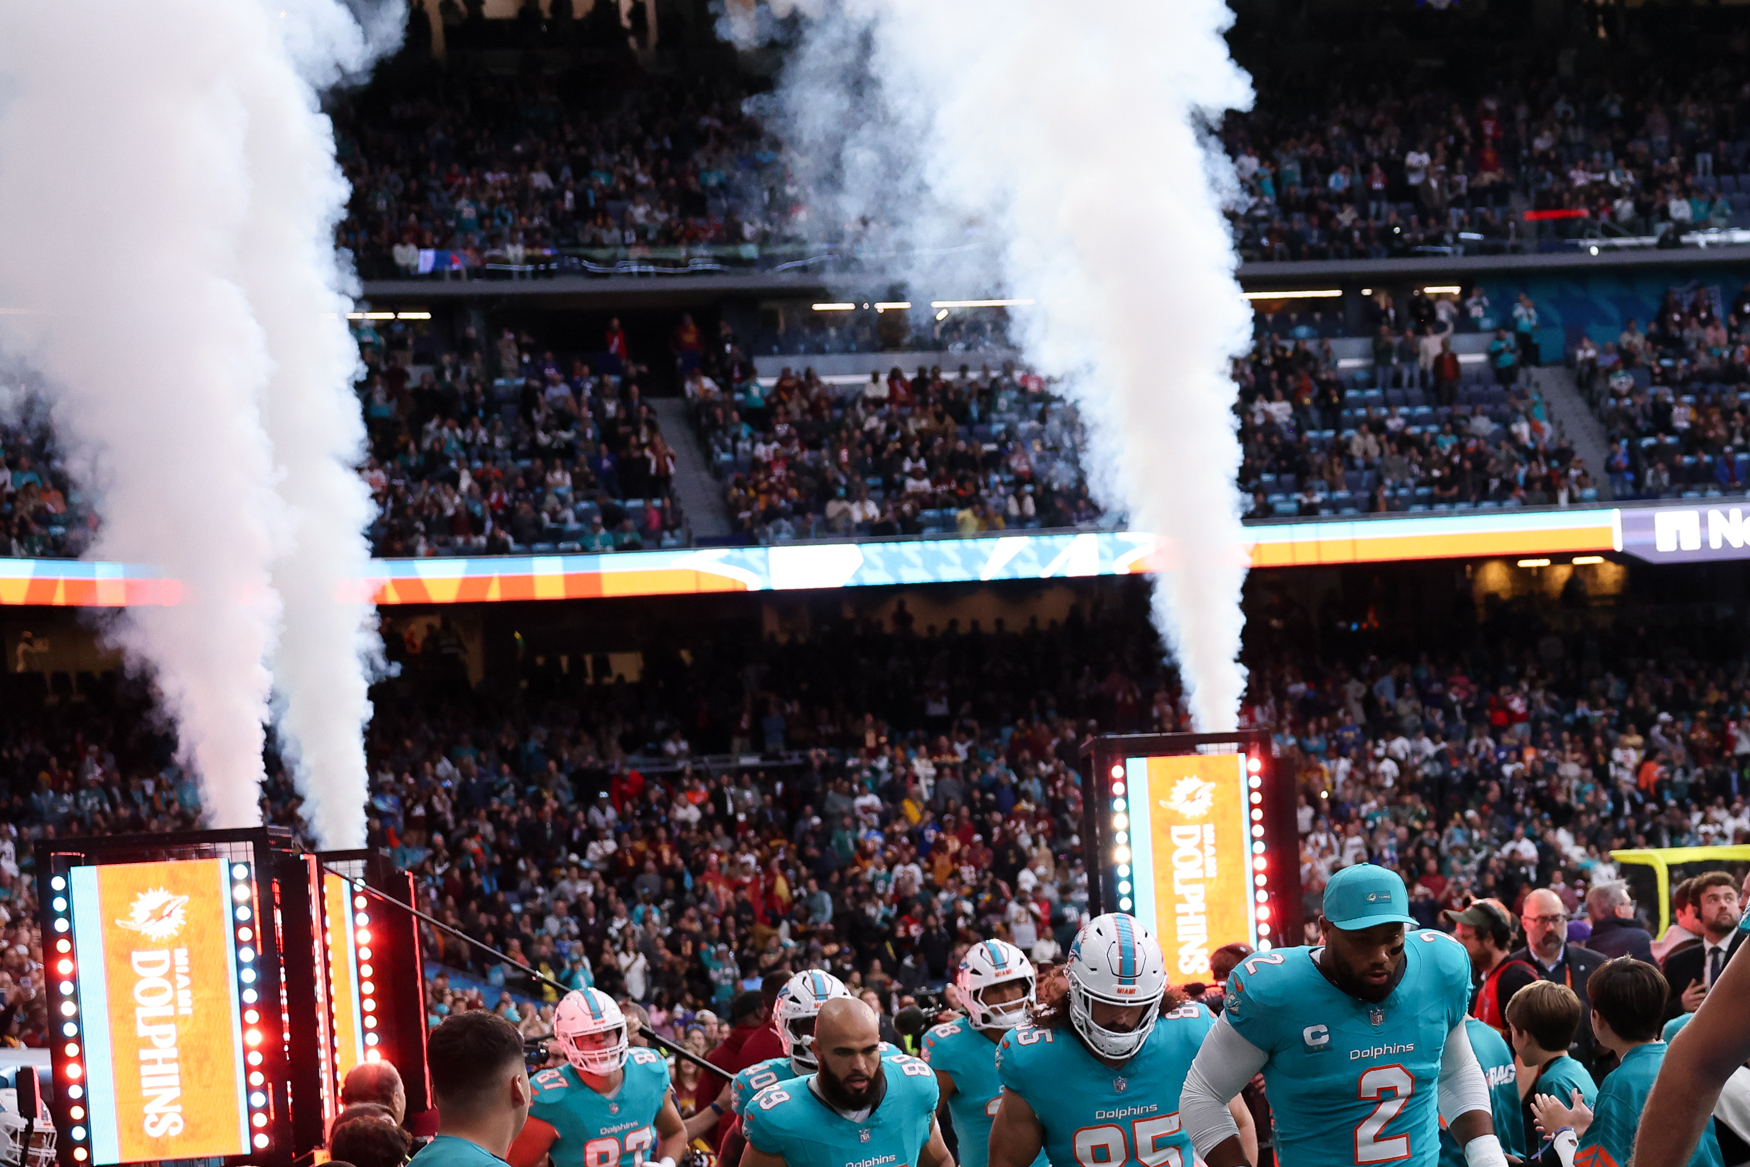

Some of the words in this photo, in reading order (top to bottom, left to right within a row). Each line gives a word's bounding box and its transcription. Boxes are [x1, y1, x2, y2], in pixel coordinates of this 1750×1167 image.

[1202, 823, 1217, 878] MIAMI
[1170, 824, 1210, 975] DOLPHINS
[1242, 952, 1286, 977] 2
[173, 947, 193, 1016] MIAMI
[1115, 986, 1137, 996] MIAMI
[131, 948, 185, 1138] DOLPHINS
[1302, 1024, 1331, 1046] C
[1349, 1041, 1415, 1062] Dolphins
[536, 1069, 570, 1091] 87
[1095, 1103, 1159, 1121] Dolphins
[1353, 1063, 1415, 1166] 2
